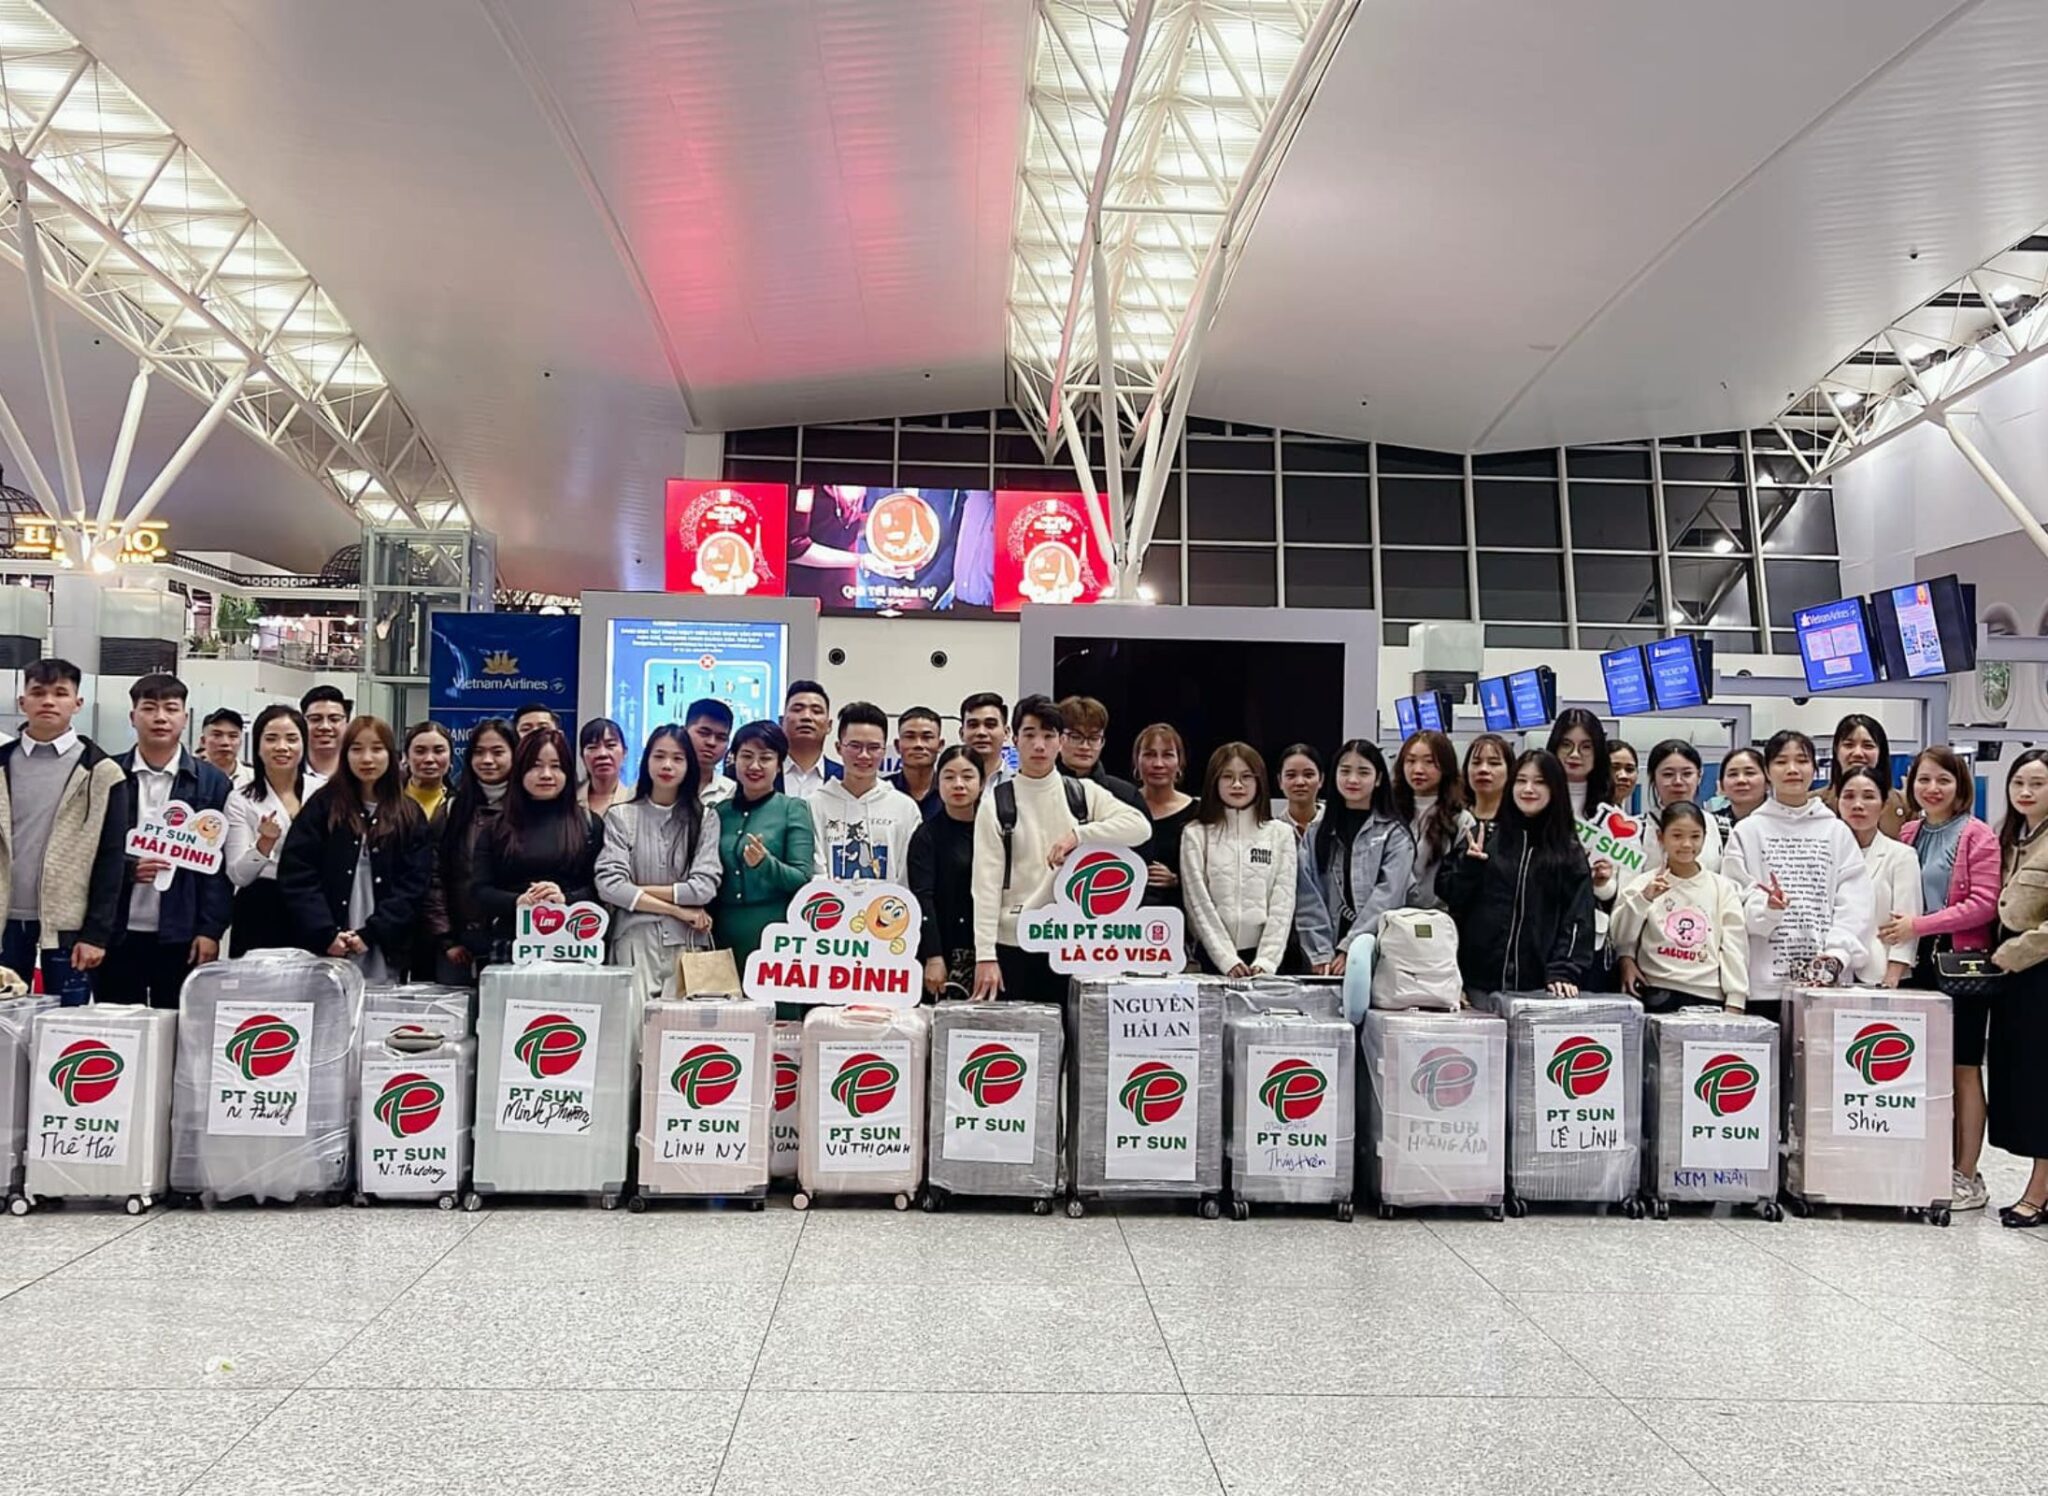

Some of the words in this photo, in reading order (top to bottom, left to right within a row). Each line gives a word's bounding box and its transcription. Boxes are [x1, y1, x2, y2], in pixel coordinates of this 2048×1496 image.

[23, 526, 51, 544] EL
[144, 823, 163, 836] PT
[166, 829, 197, 845] SUN
[1596, 836, 1643, 870] SUN
[523, 910, 530, 935] I
[1074, 924, 1097, 940] PT
[1103, 924, 1142, 940] SUN
[519, 945, 545, 958] PT
[553, 945, 597, 958] SUN
[774, 936, 806, 954] PT
[816, 938, 869, 957] SUN
[1061, 945, 1086, 961] LÀ
[1092, 945, 1119, 961] CÓ
[1125, 948, 1172, 962] VISA
[757, 959, 820, 989] MÃI
[828, 960, 910, 993] ĐỈNH
[1164, 1022, 1191, 1037] AN
[221, 1090, 247, 1104] PT
[253, 1091, 297, 1105] SUN
[510, 1087, 535, 1101] PT
[541, 1089, 583, 1103] SUN
[1844, 1093, 1868, 1107] PT
[1875, 1095, 1916, 1109] SUN
[1547, 1109, 1570, 1122] PT
[1576, 1108, 1615, 1122] SUN
[1847, 1110, 1890, 1133] Shin
[43, 1115, 68, 1130] PT
[74, 1117, 119, 1133] SUN
[667, 1118, 692, 1131] PT
[698, 1119, 740, 1133] SUN
[956, 1116, 979, 1131] PT
[985, 1118, 1025, 1133] SUN
[770, 1126, 799, 1139] UN
[830, 1128, 854, 1140] PT
[860, 1127, 900, 1140] SUN
[1257, 1132, 1281, 1146] PT
[1287, 1133, 1327, 1147] SUN
[1692, 1126, 1716, 1139] PT
[1722, 1126, 1760, 1140] SUN
[1116, 1136, 1141, 1149] PT
[1147, 1136, 1187, 1150] SUN
[373, 1148, 398, 1161] PT
[404, 1147, 447, 1161] SUN
